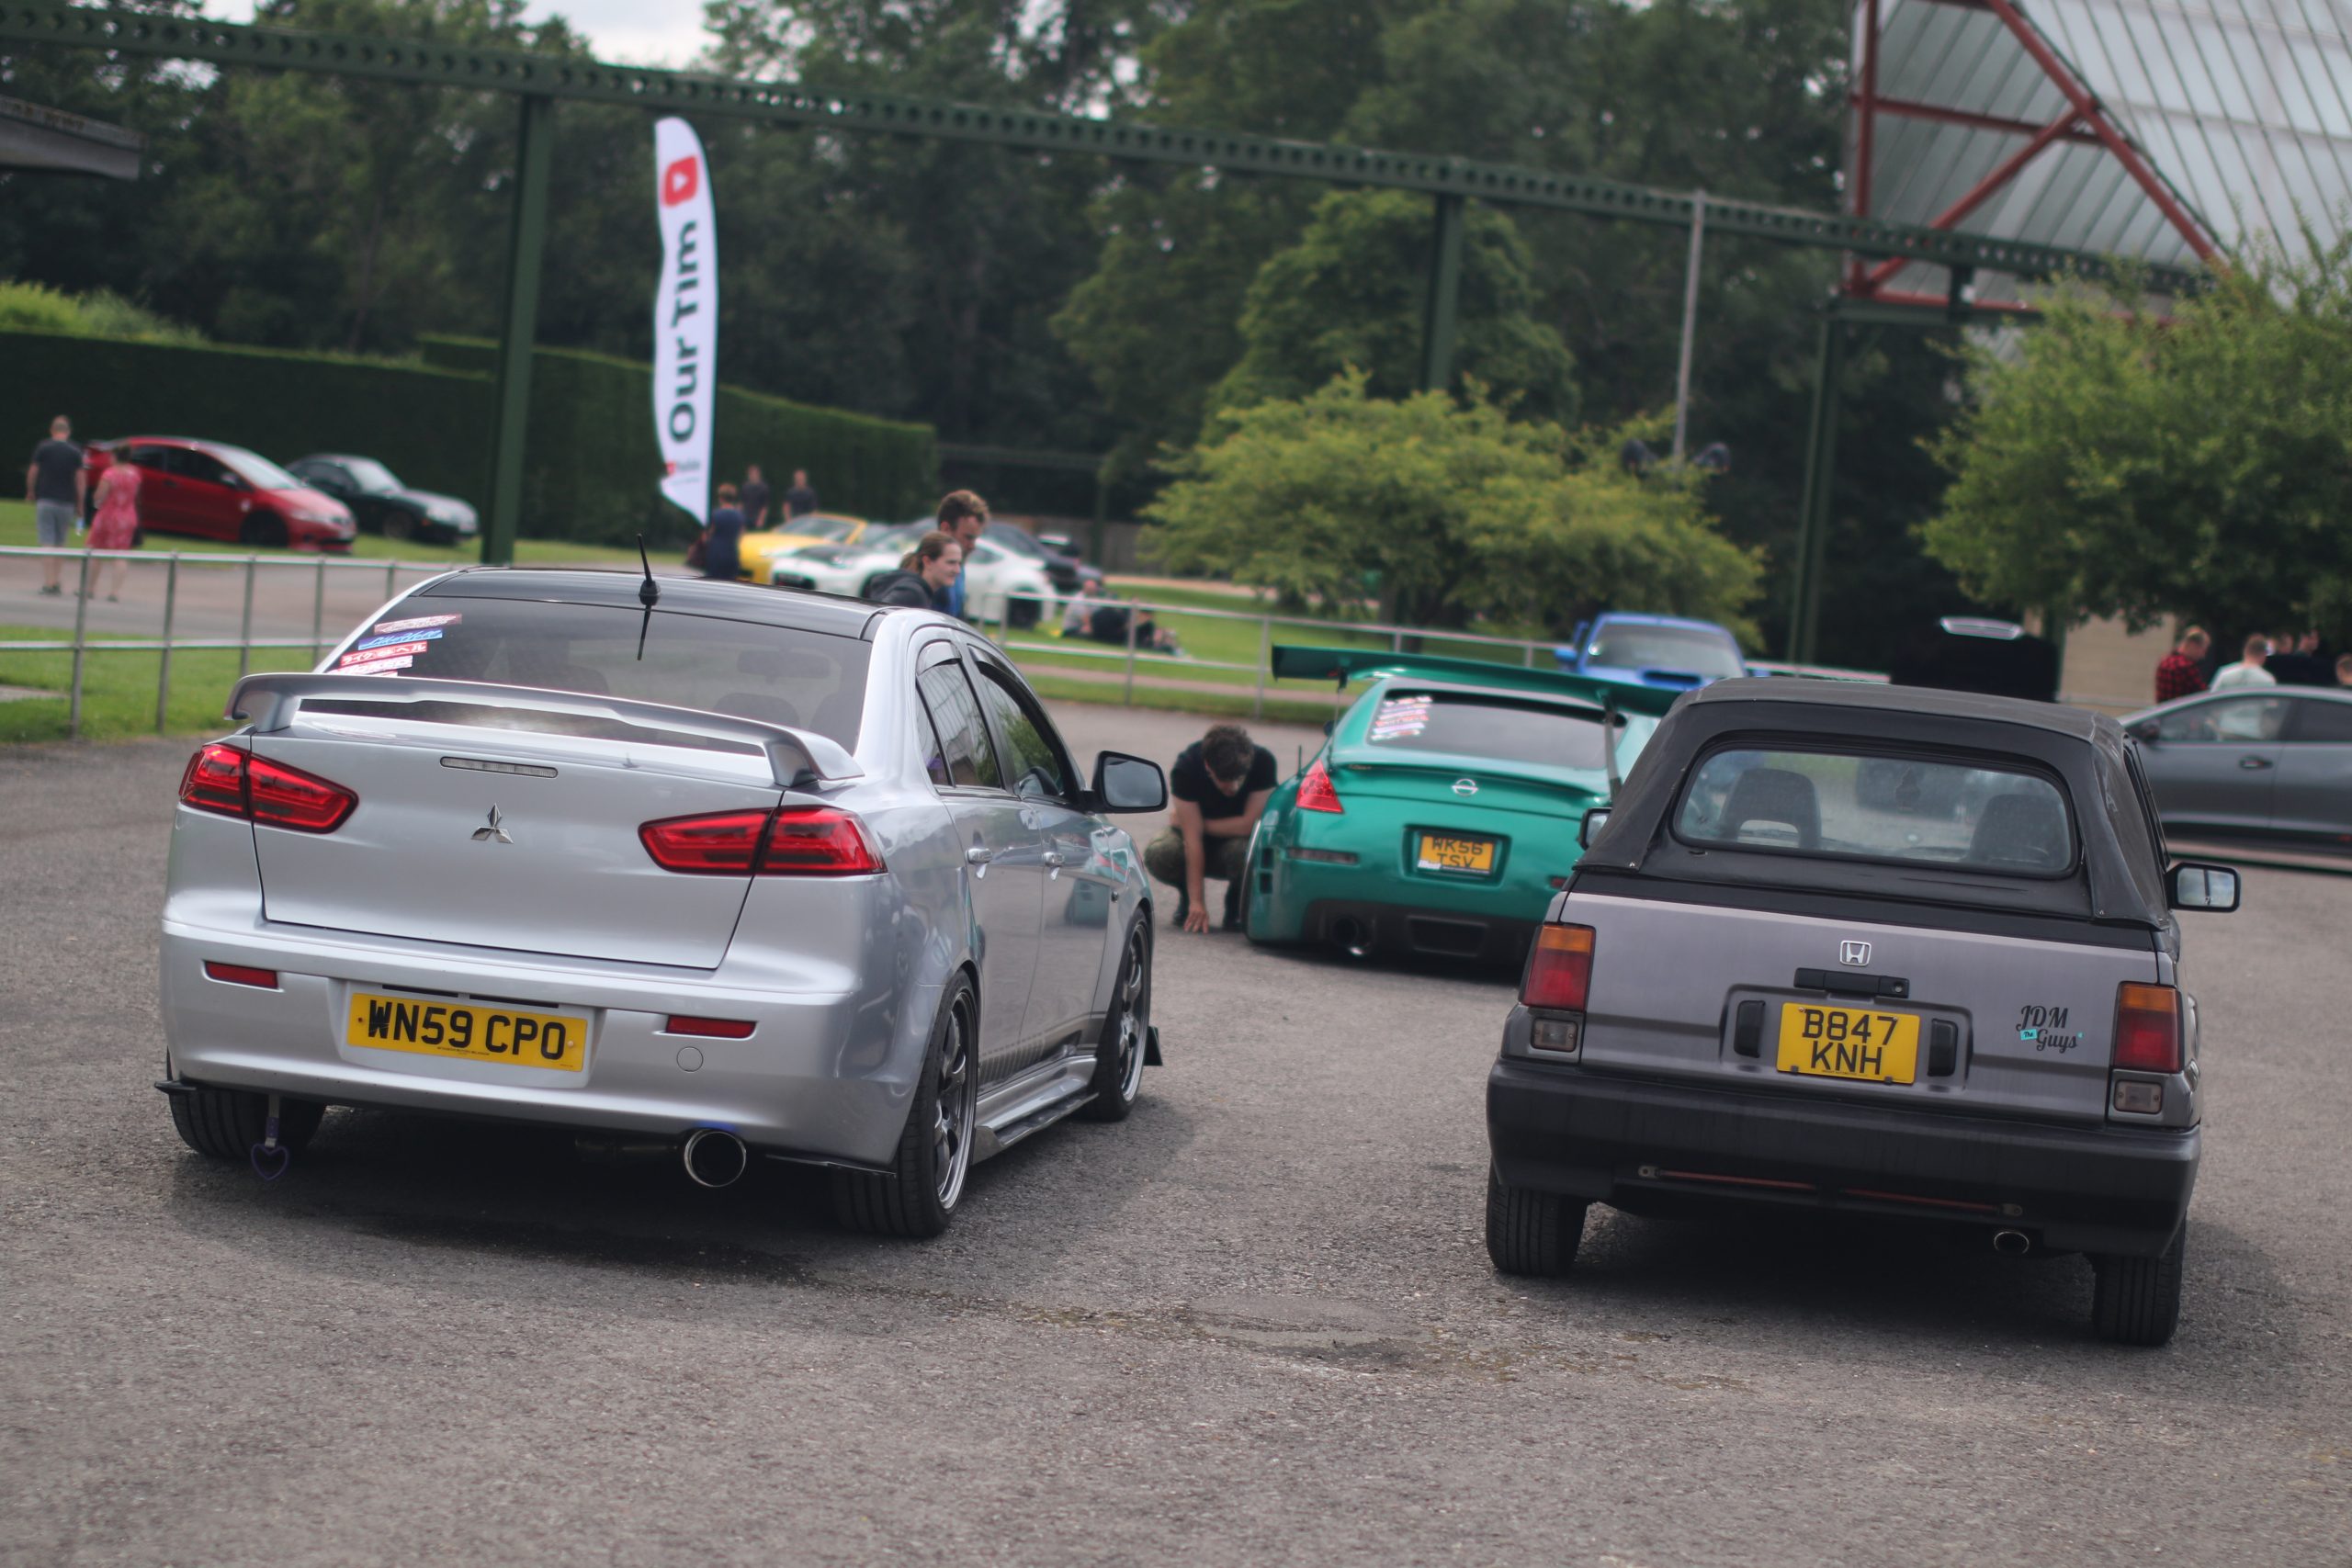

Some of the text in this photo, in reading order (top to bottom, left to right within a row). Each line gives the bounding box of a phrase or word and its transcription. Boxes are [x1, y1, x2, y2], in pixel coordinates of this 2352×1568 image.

[671, 220, 699, 329] Tim
[668, 335, 698, 444] Our
[1432, 837, 1484, 856] WK56
[1436, 852, 1476, 868] TSV
[368, 999, 566, 1060] WN59 CPO
[1802, 1009, 1898, 1045] B847
[2015, 1005, 2068, 1032] JDM
[1810, 1040, 1883, 1075] KNH
[2036, 1029, 2078, 1054] Guys
